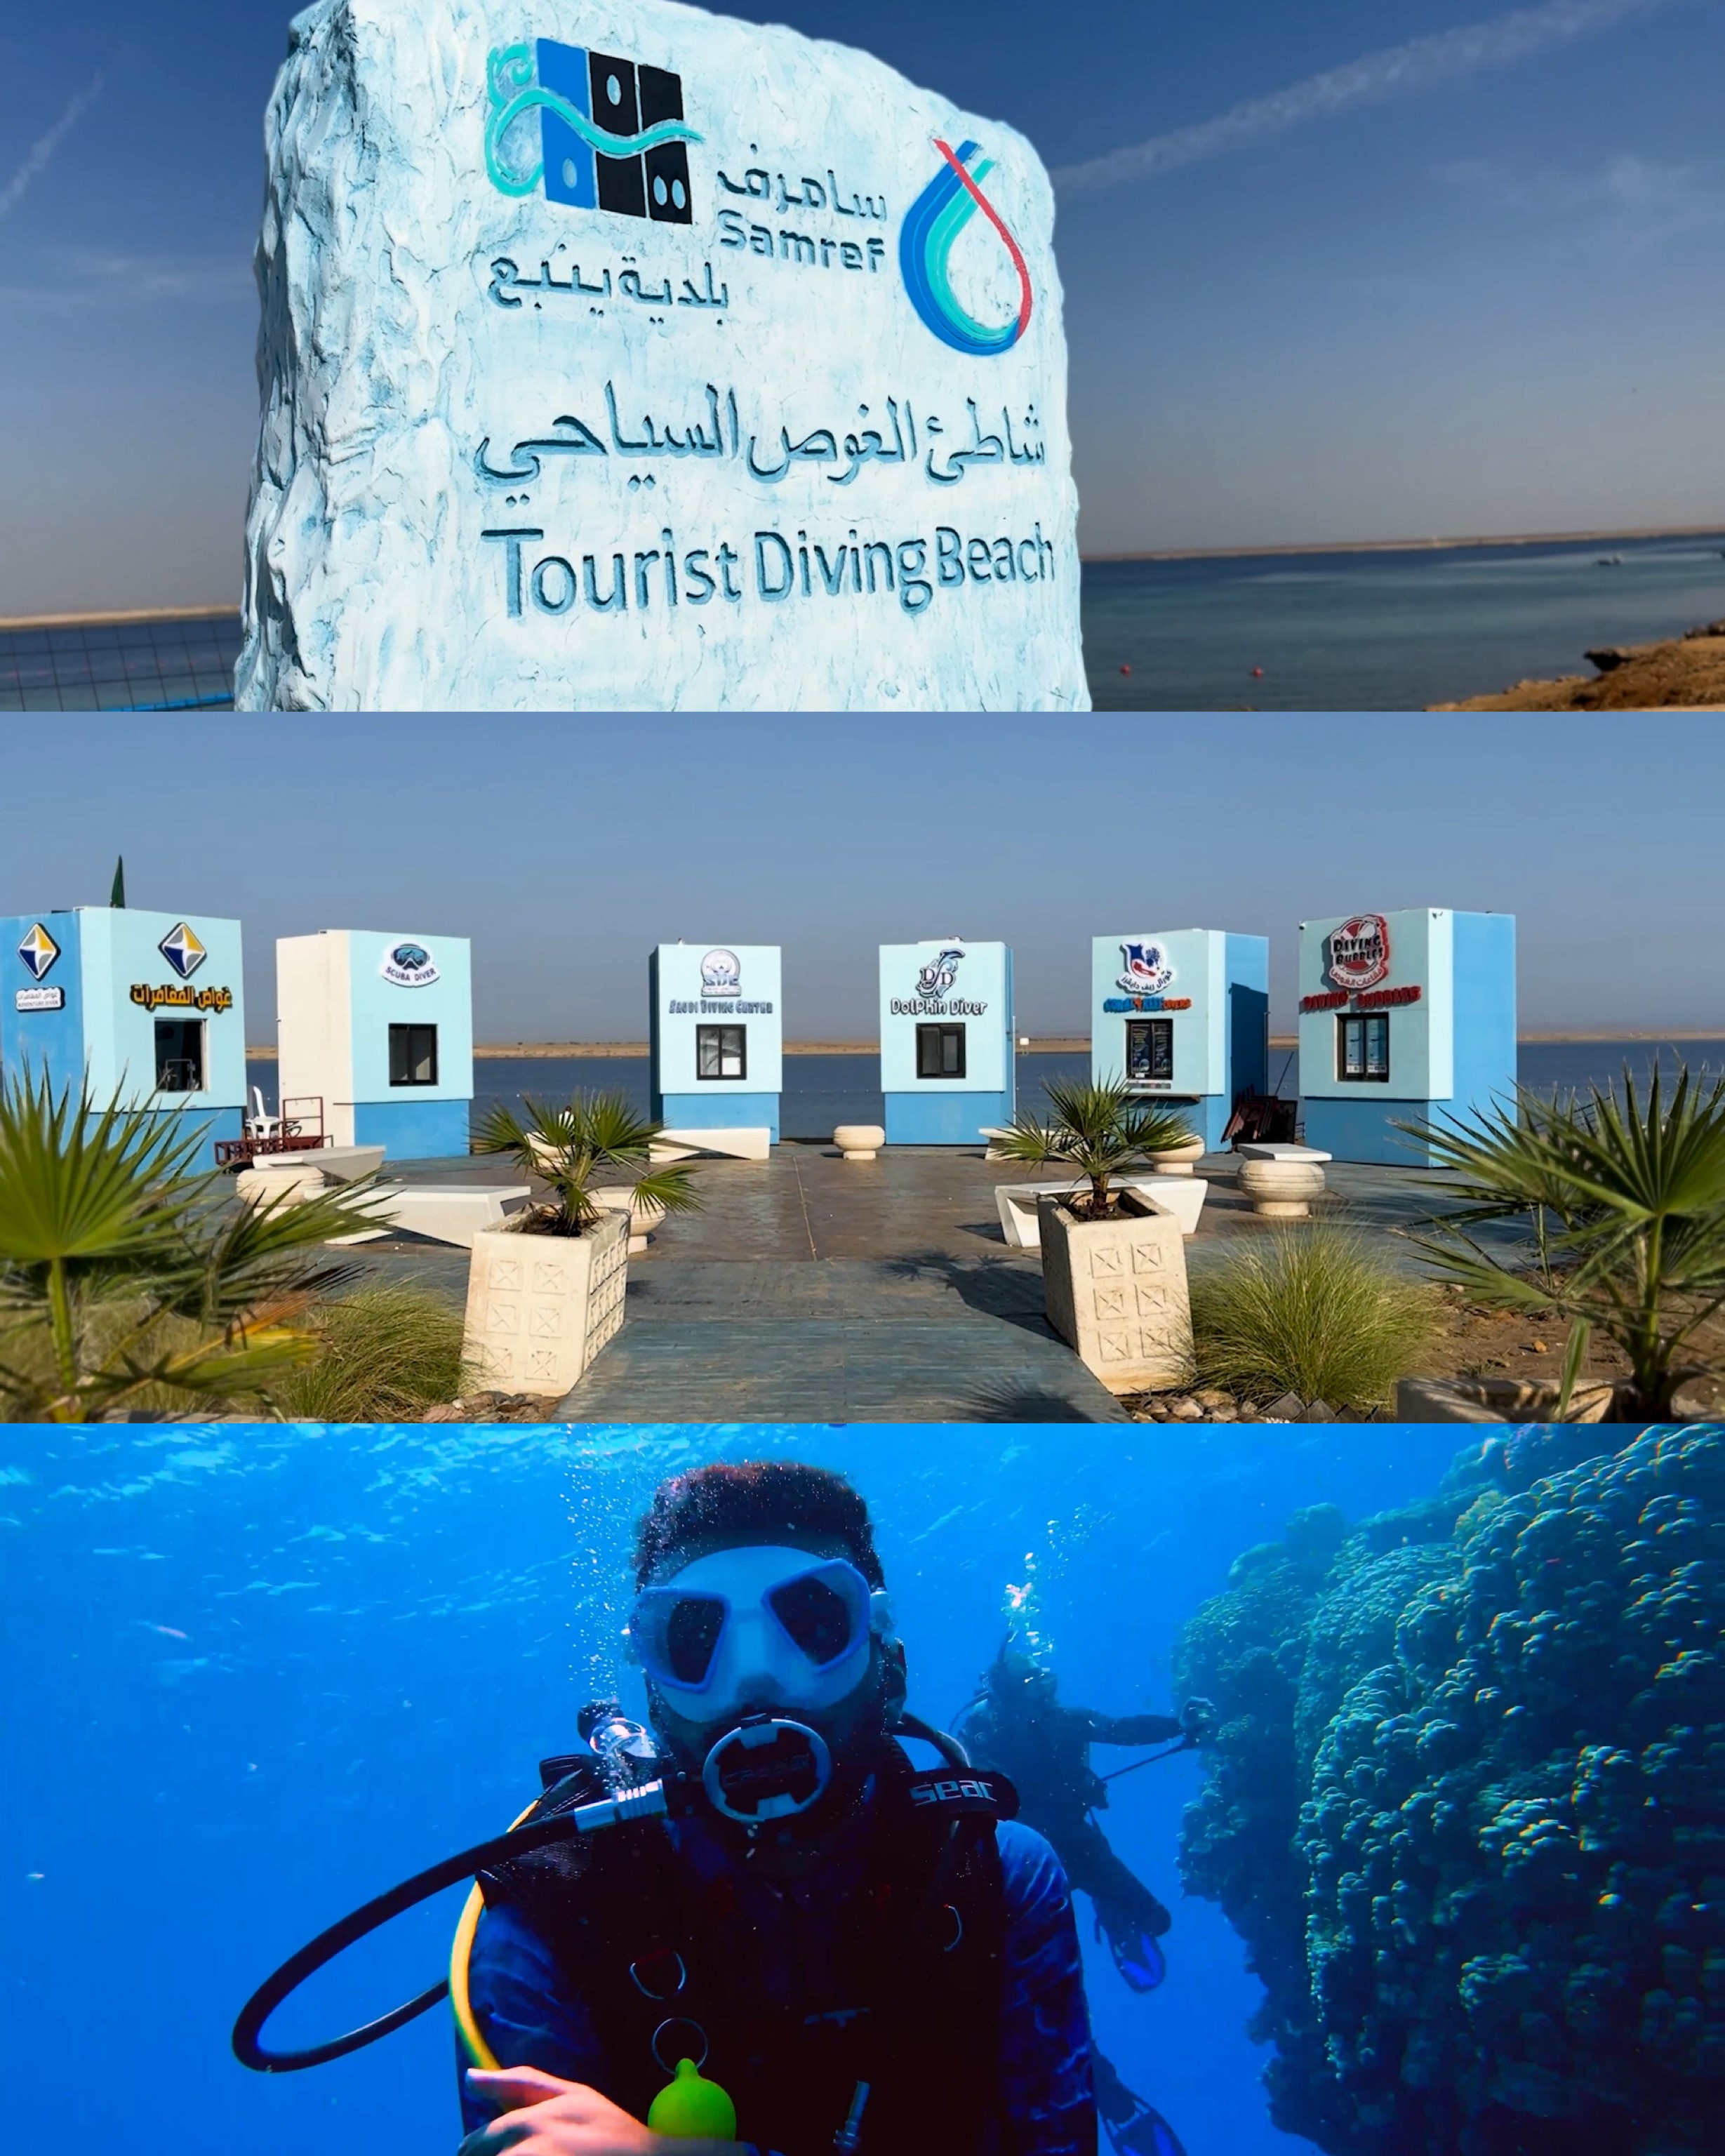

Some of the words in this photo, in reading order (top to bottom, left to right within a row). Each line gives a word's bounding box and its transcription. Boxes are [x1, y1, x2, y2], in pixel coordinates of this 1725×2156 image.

[717, 142, 887, 222] سامرف
[717, 208, 885, 273] Samref
[488, 244, 611, 317] ينبع
[618, 255, 728, 326] بلدية
[474, 380, 739, 507] السياحي
[746, 394, 918, 486] الغوص
[925, 396, 1045, 487] شاطئ
[481, 528, 742, 618] Tourist
[754, 529, 934, 614] Diving
[935, 521, 1055, 588] Beach
[385, 966, 411, 981] SCUBA
[414, 968, 436, 981] DIVER
[1333, 935, 1381, 952] DIVING
[1336, 947, 1383, 966] BUBBLES
[131, 984, 196, 1012] المغامرات
[197, 985, 232, 1013] غواص
[700, 999, 734, 1013] DIVING
[950, 997, 987, 1016] Diver
